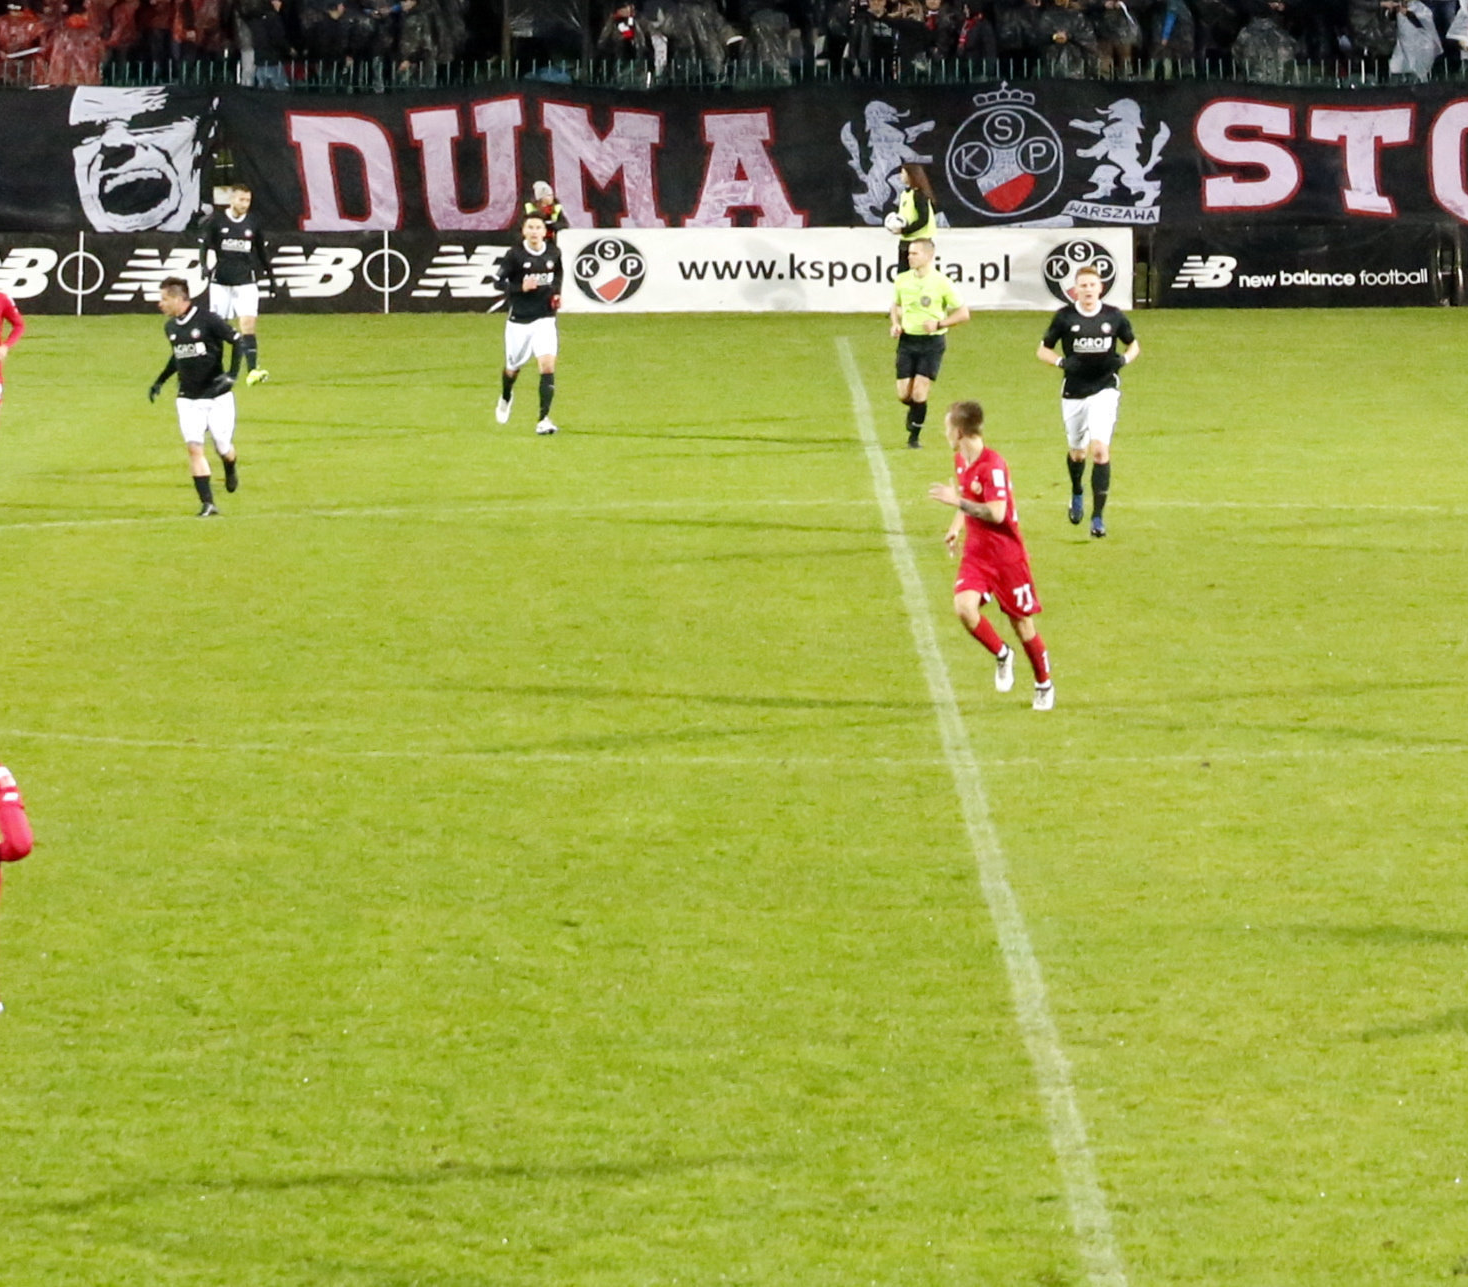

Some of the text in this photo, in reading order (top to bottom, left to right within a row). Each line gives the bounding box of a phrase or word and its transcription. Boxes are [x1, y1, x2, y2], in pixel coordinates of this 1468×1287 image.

[286, 96, 809, 231] DUMA
[1068, 202, 1157, 221] WARSZAWA
[1239, 273, 1276, 288] new
[1280, 270, 1355, 286] balance
[1360, 268, 1427, 286] football
[1074, 337, 1103, 349] AGRO
